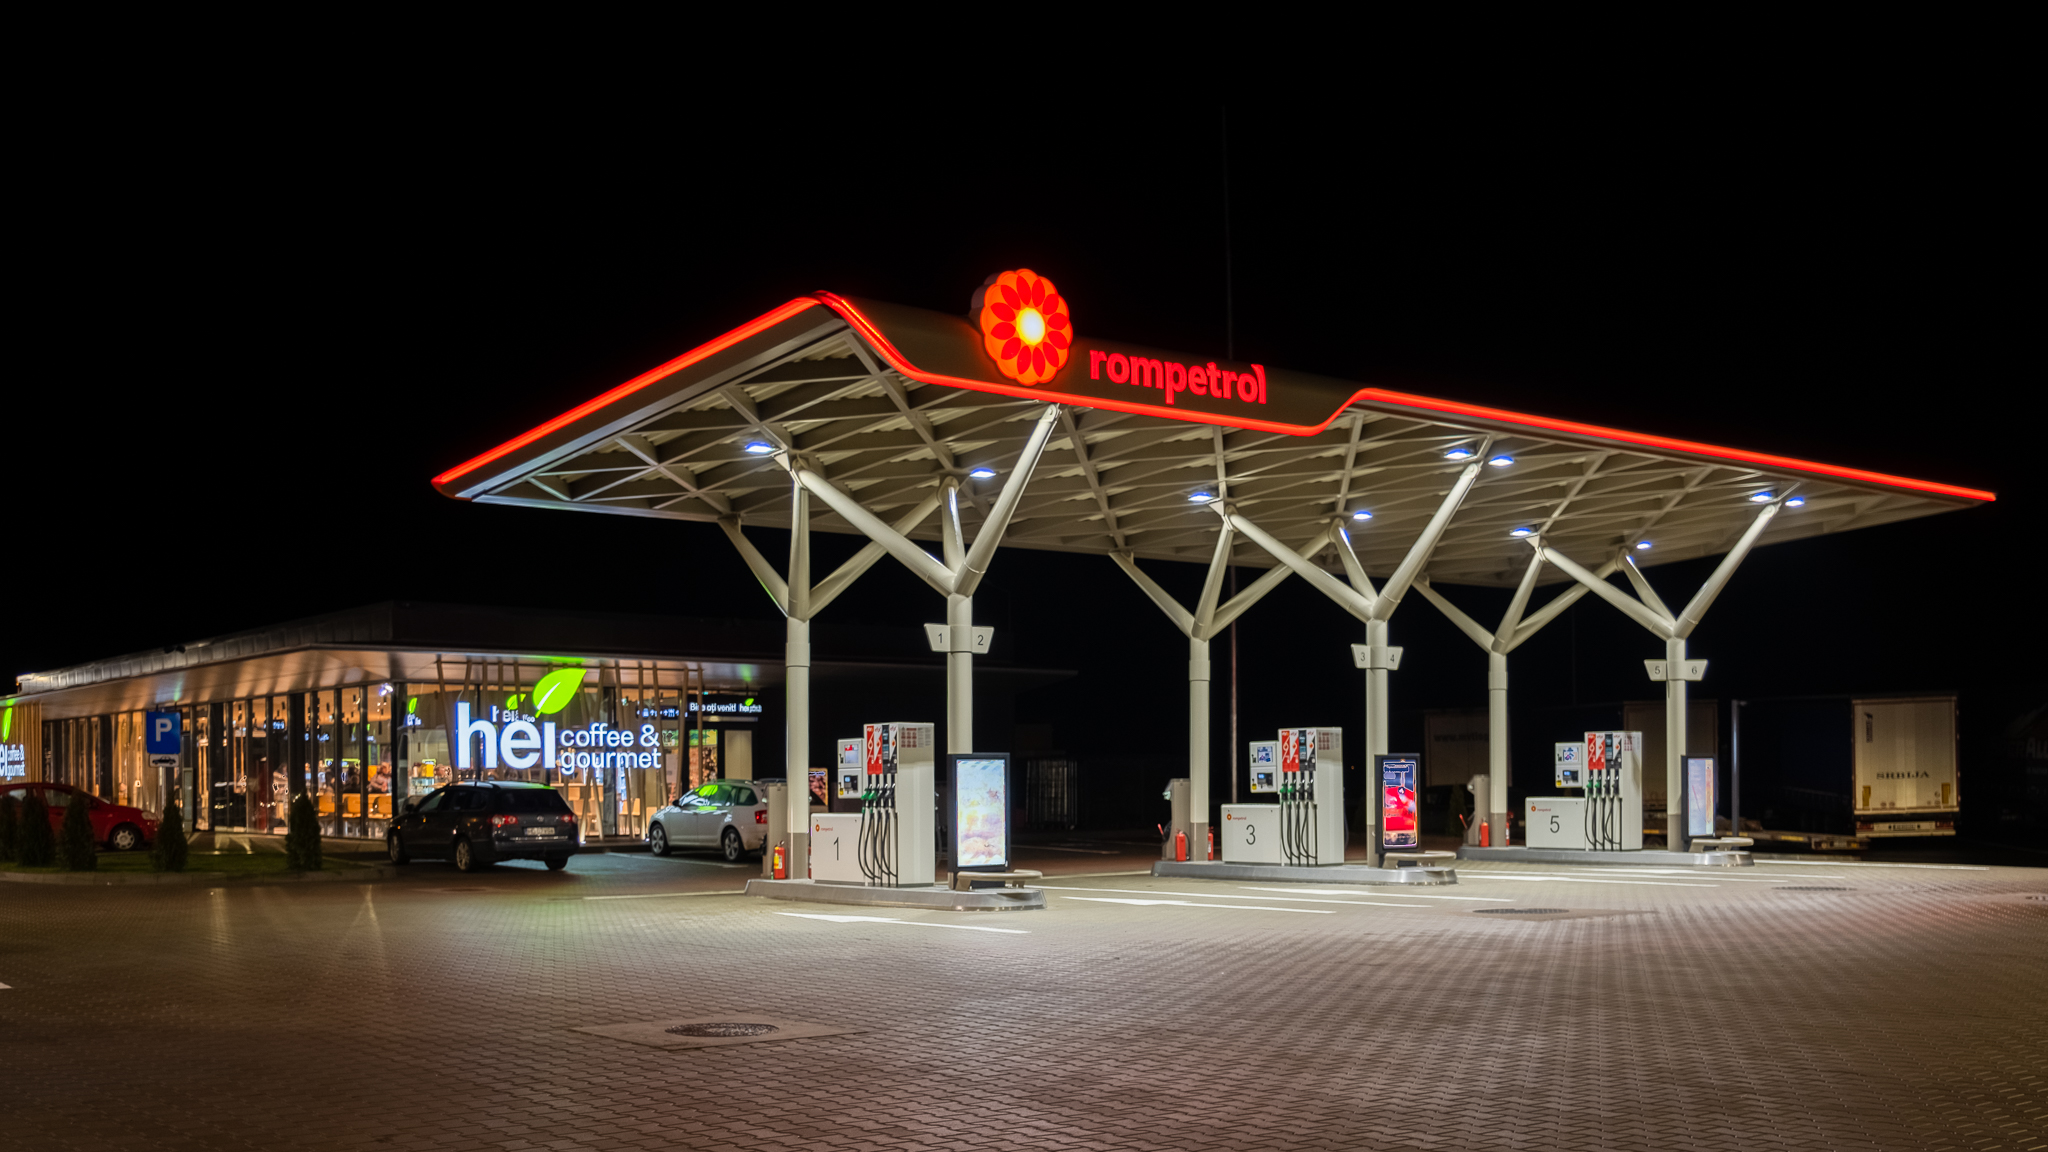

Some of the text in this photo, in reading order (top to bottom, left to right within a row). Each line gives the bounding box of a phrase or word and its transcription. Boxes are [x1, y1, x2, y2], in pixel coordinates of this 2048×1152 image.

[1089, 349, 1267, 405] rompetrol
[937, 633, 943, 644] 1
[977, 634, 984, 646] 2
[1360, 651, 1366, 662] 3
[1389, 653, 1395, 664] 4
[1654, 665, 1661, 675] 5
[1691, 665, 1698, 675] 6
[155, 718, 173, 742] P
[560, 721, 660, 748] coffee &
[560, 747, 662, 775] gourmet
[1876, 770, 1930, 780] SRBIJA
[1549, 815, 1560, 834] 5
[1245, 824, 1257, 846] 3
[833, 836, 840, 861] 1
